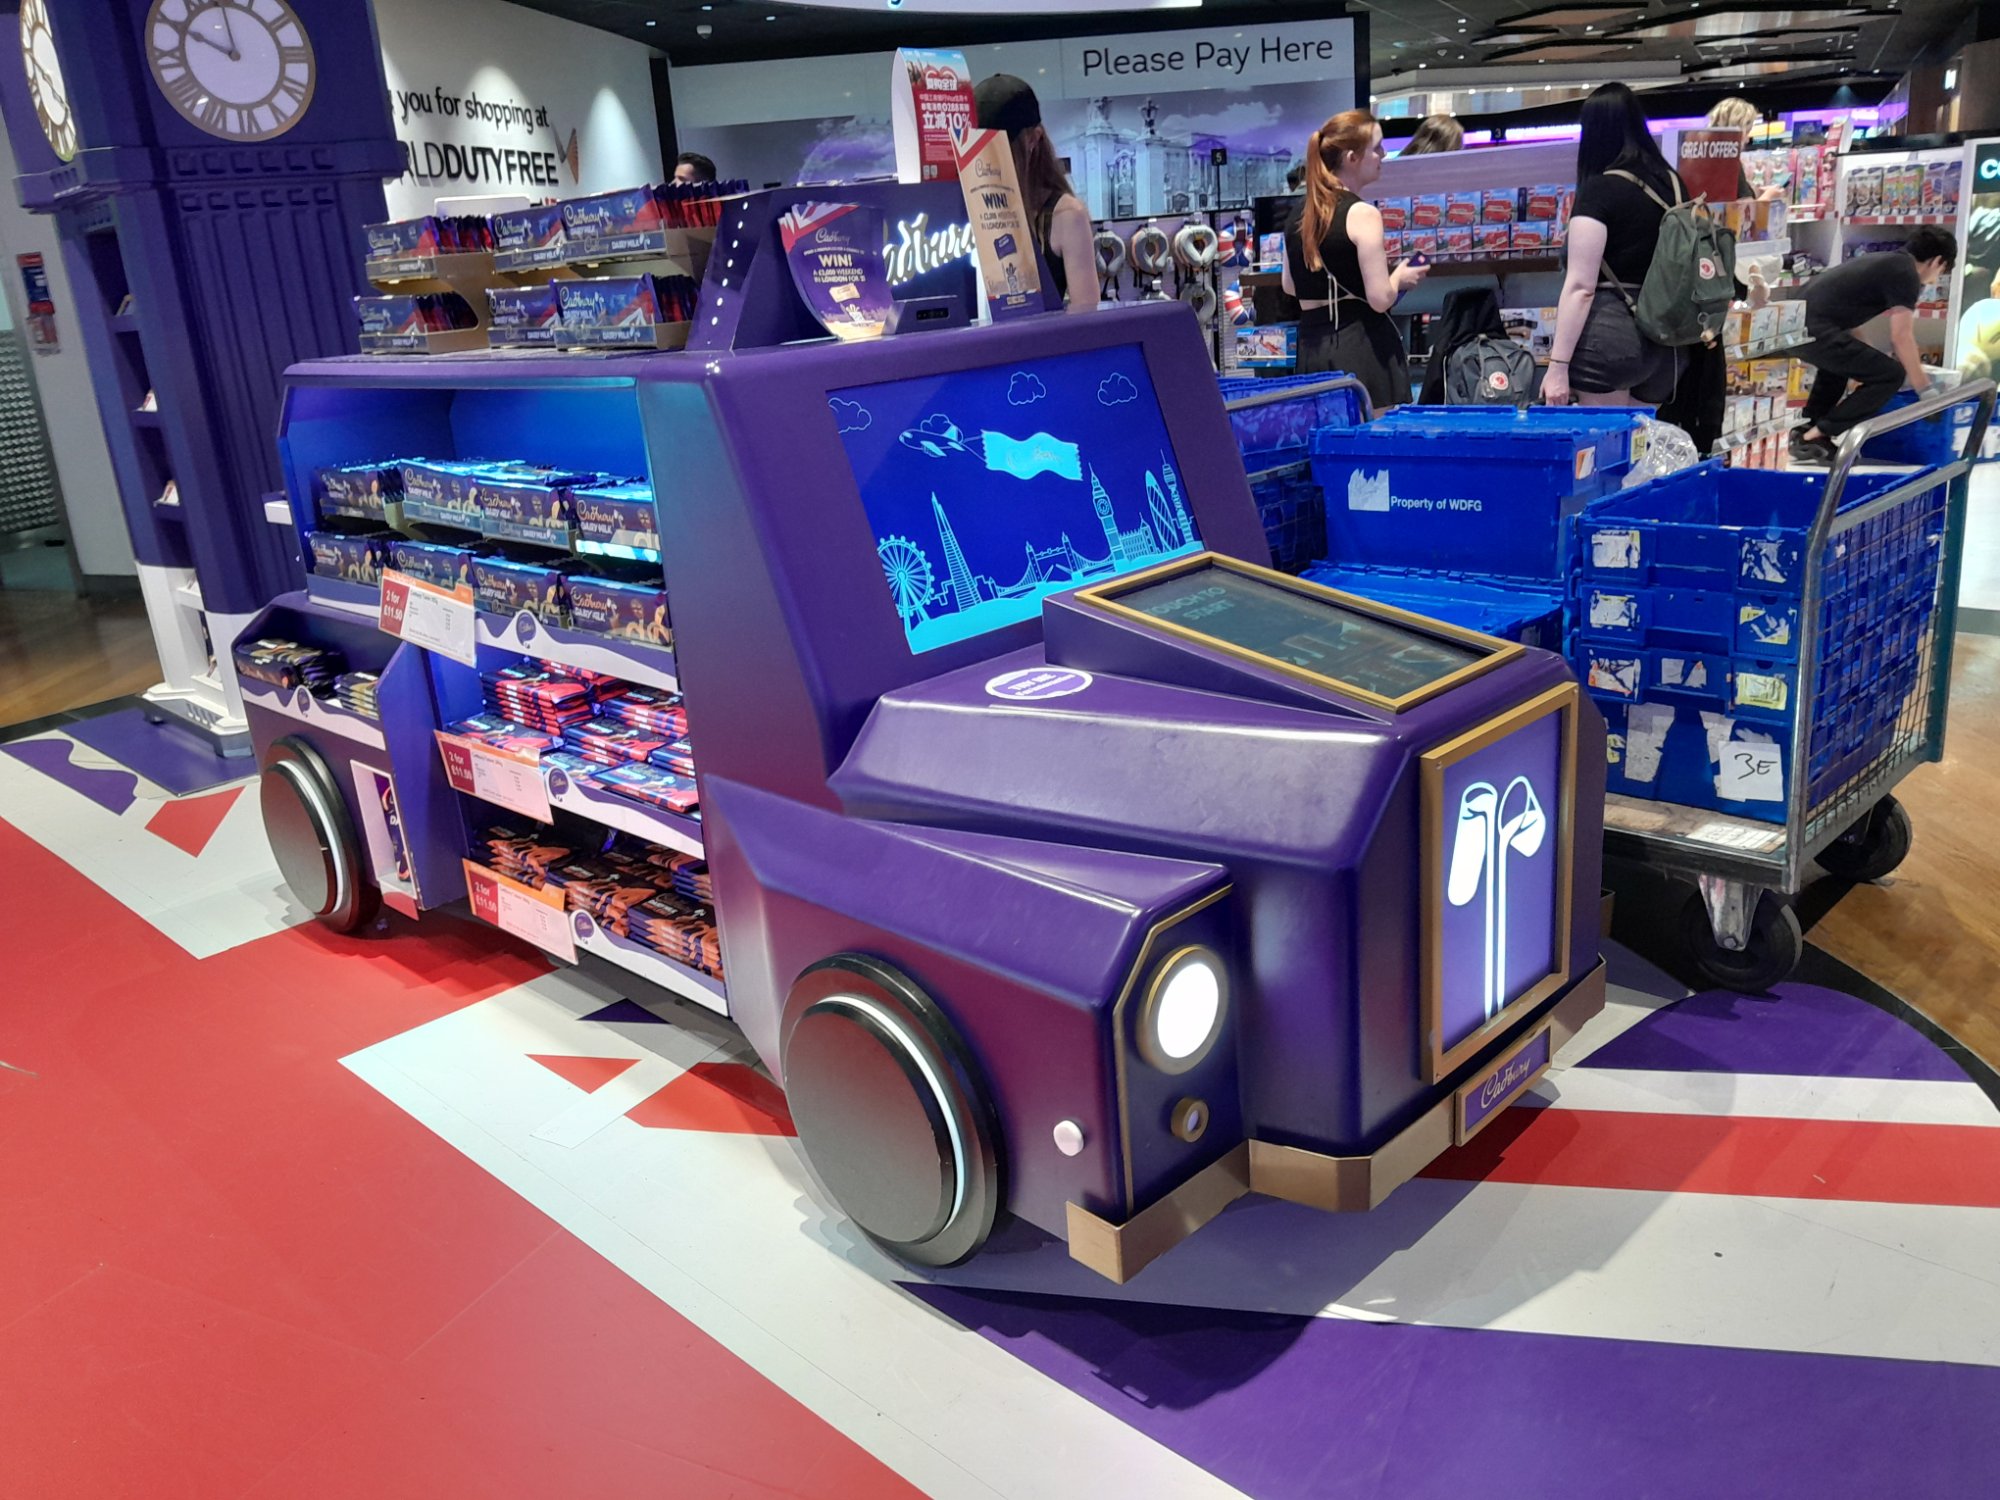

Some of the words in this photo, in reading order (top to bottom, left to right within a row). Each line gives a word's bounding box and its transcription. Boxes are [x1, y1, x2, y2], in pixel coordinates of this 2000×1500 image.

[1083, 48, 1184, 77] Please
[1196, 40, 1251, 74] Pay
[1261, 37, 1333, 64] Here
[398, 90, 432, 119] you
[435, 87, 461, 116] for
[465, 92, 533, 135] shopping
[535, 106, 549, 128] at
[1681, 142, 1708, 158] GREAT
[1709, 141, 1738, 158] OFFERS
[982, 192, 1008, 209] WIN!
[816, 228, 850, 245] Cadbury
[818, 254, 852, 267] WIN!
[1390, 496, 1433, 511] Property
[1436, 499, 1447, 509] of
[1449, 498, 1483, 512] WDFG
[577, 500, 614, 527] Cadbury
[386, 590, 391, 600] 2
[391, 591, 400, 604] for
[448, 752, 454, 761] 2
[1734, 753, 1777, 780] 3E
[475, 882, 481, 892] 2
[1481, 1058, 1531, 1109] Cadbury
